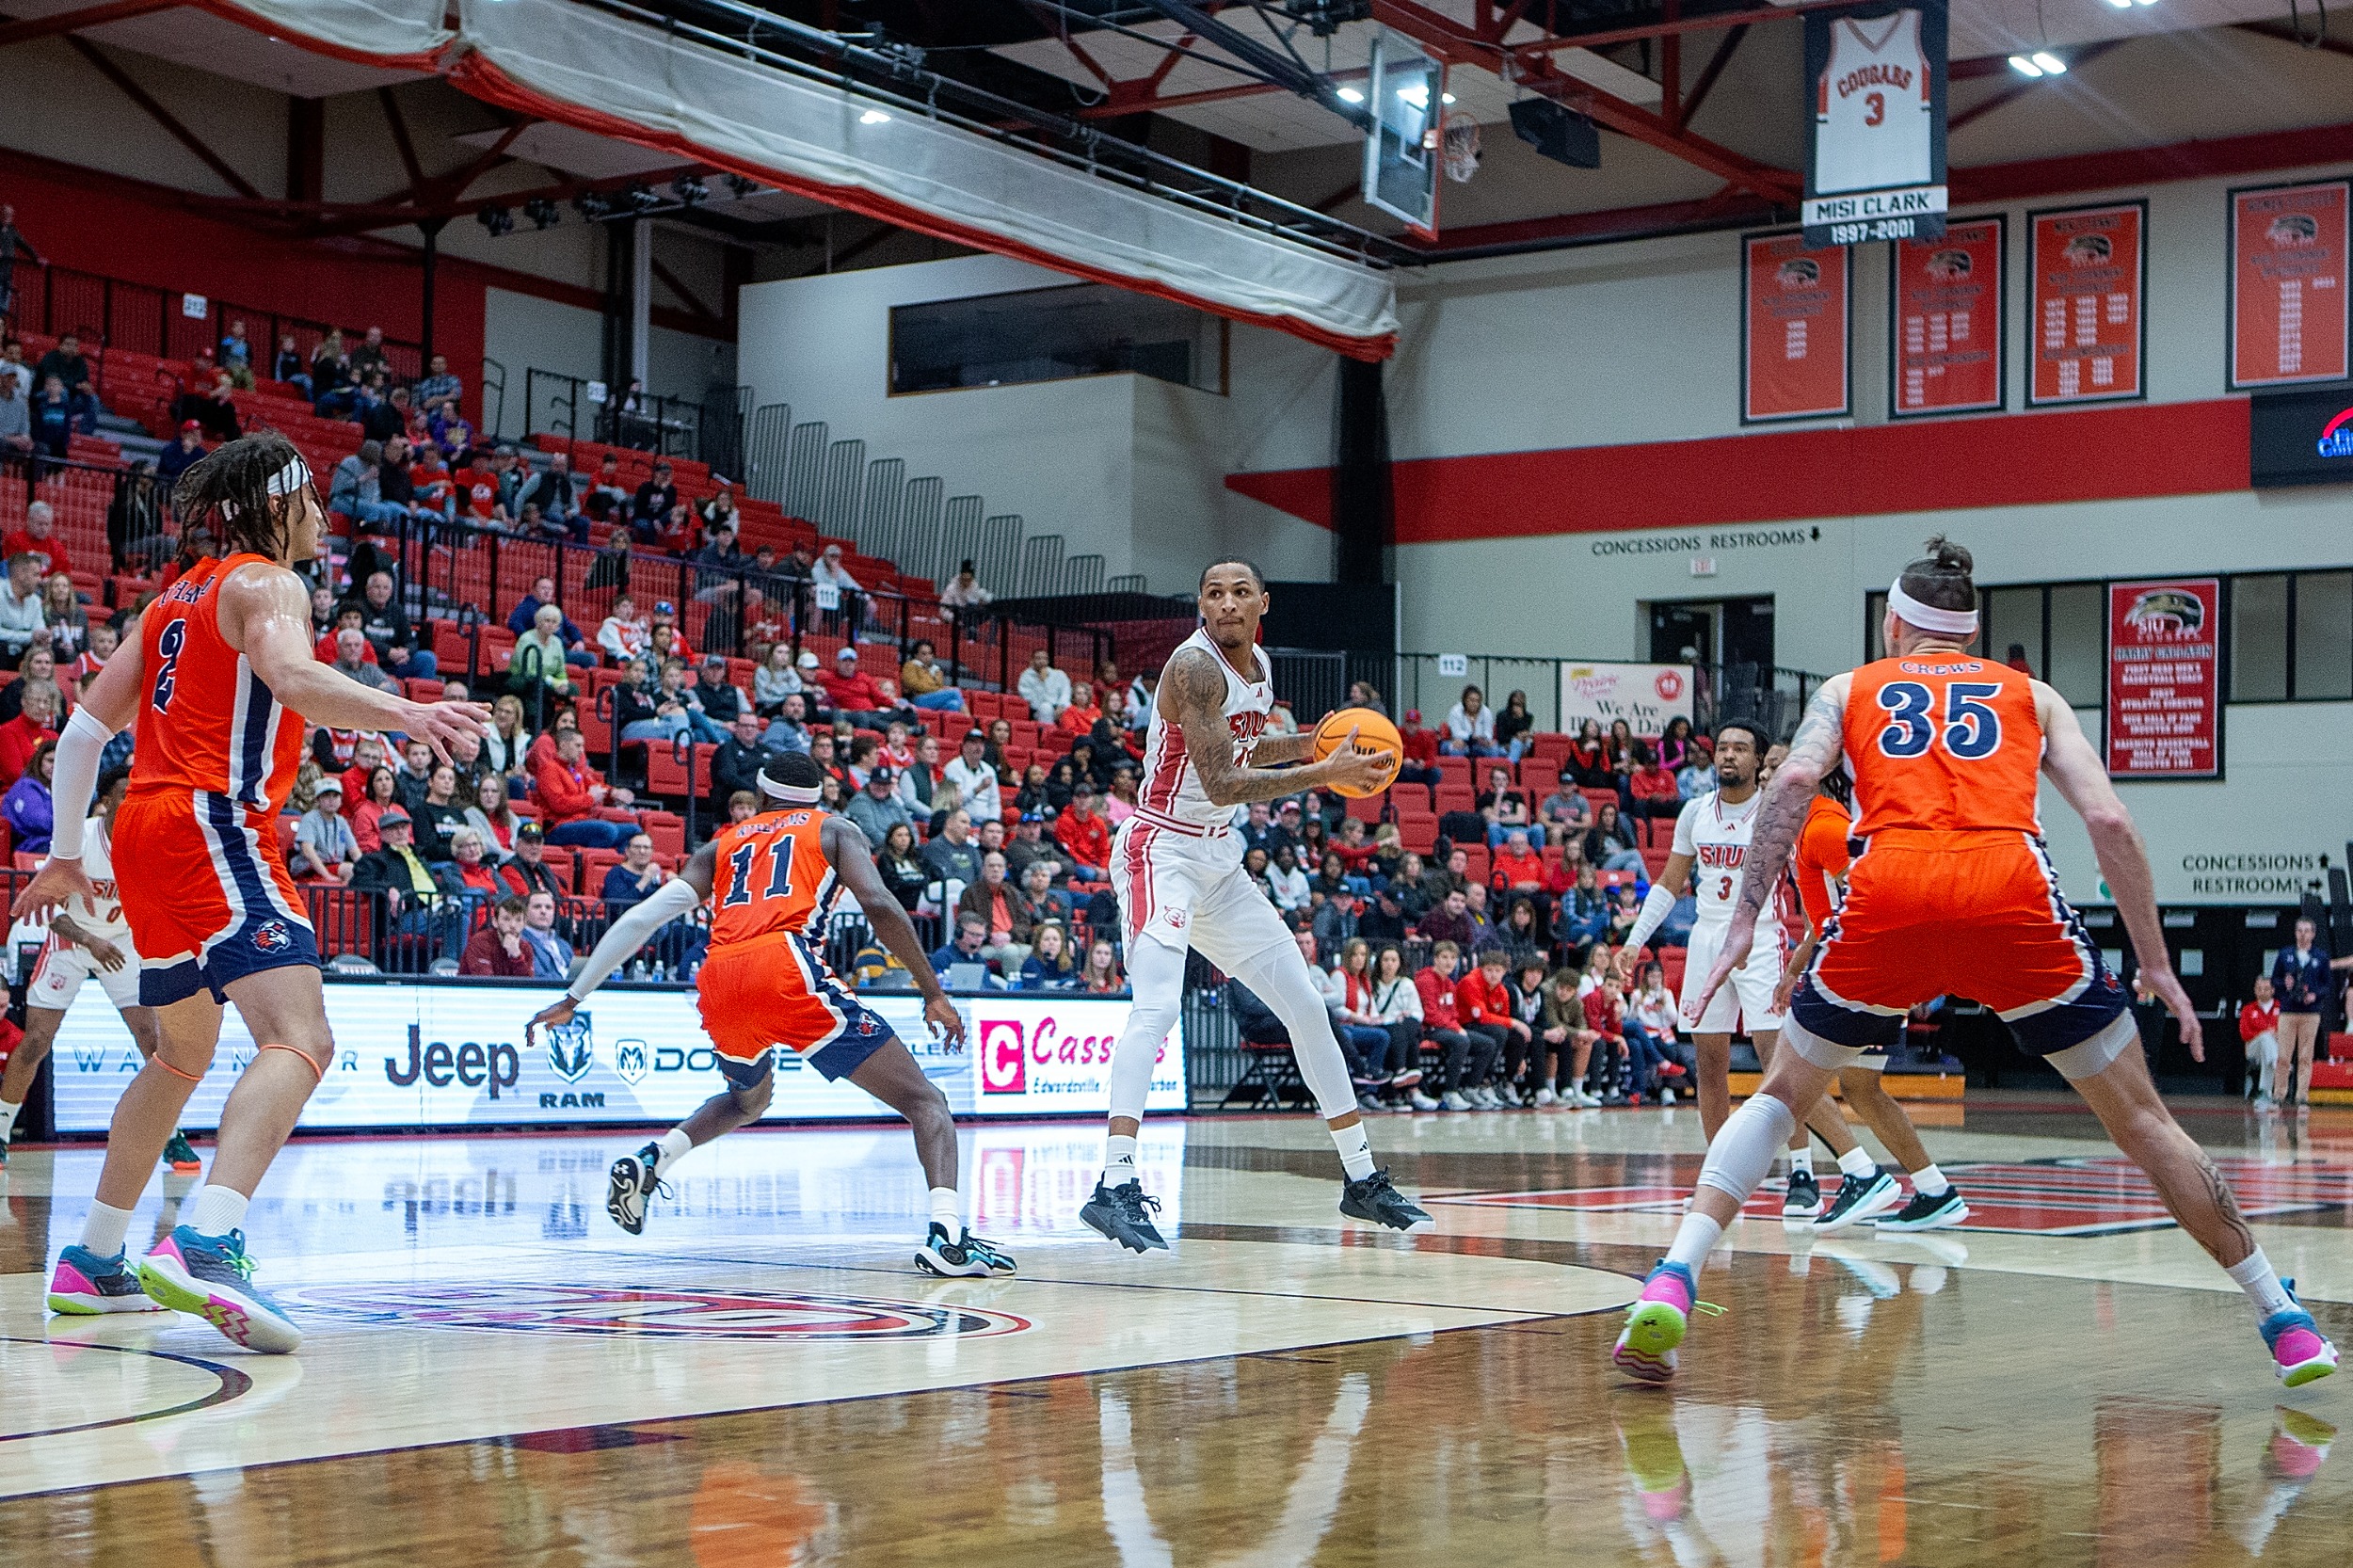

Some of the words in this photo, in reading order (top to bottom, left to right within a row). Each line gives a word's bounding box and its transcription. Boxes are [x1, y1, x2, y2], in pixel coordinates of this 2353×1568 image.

[1865, 92, 1884, 126] 3
[1817, 200, 1855, 219] MISI
[1864, 192, 1929, 215] CLARK
[1831, 217, 1914, 244] 1997-2001
[1592, 536, 1701, 555] CONCESSIONS
[1710, 529, 1805, 549] RESTROOMS
[152, 618, 186, 715] 2
[1443, 660, 1465, 672] 112
[1899, 662, 1984, 676] CREWS
[1597, 700, 1624, 715] We
[1629, 701, 1658, 716] Are
[1876, 680, 2003, 760] 35
[1226, 710, 1269, 744] SIU
[722, 833, 795, 909] 11
[2183, 854, 2313, 872] CONCESSIONS
[1717, 875, 1734, 901] 3
[2193, 876, 2303, 894] RESTROOMS
[106, 905, 122, 923] 0
[1032, 1016, 1169, 1065] Casss
[384, 1023, 520, 1100] Jeep
[1033, 1077, 1100, 1094] Edwardsville
[538, 1092, 606, 1109] RAM
